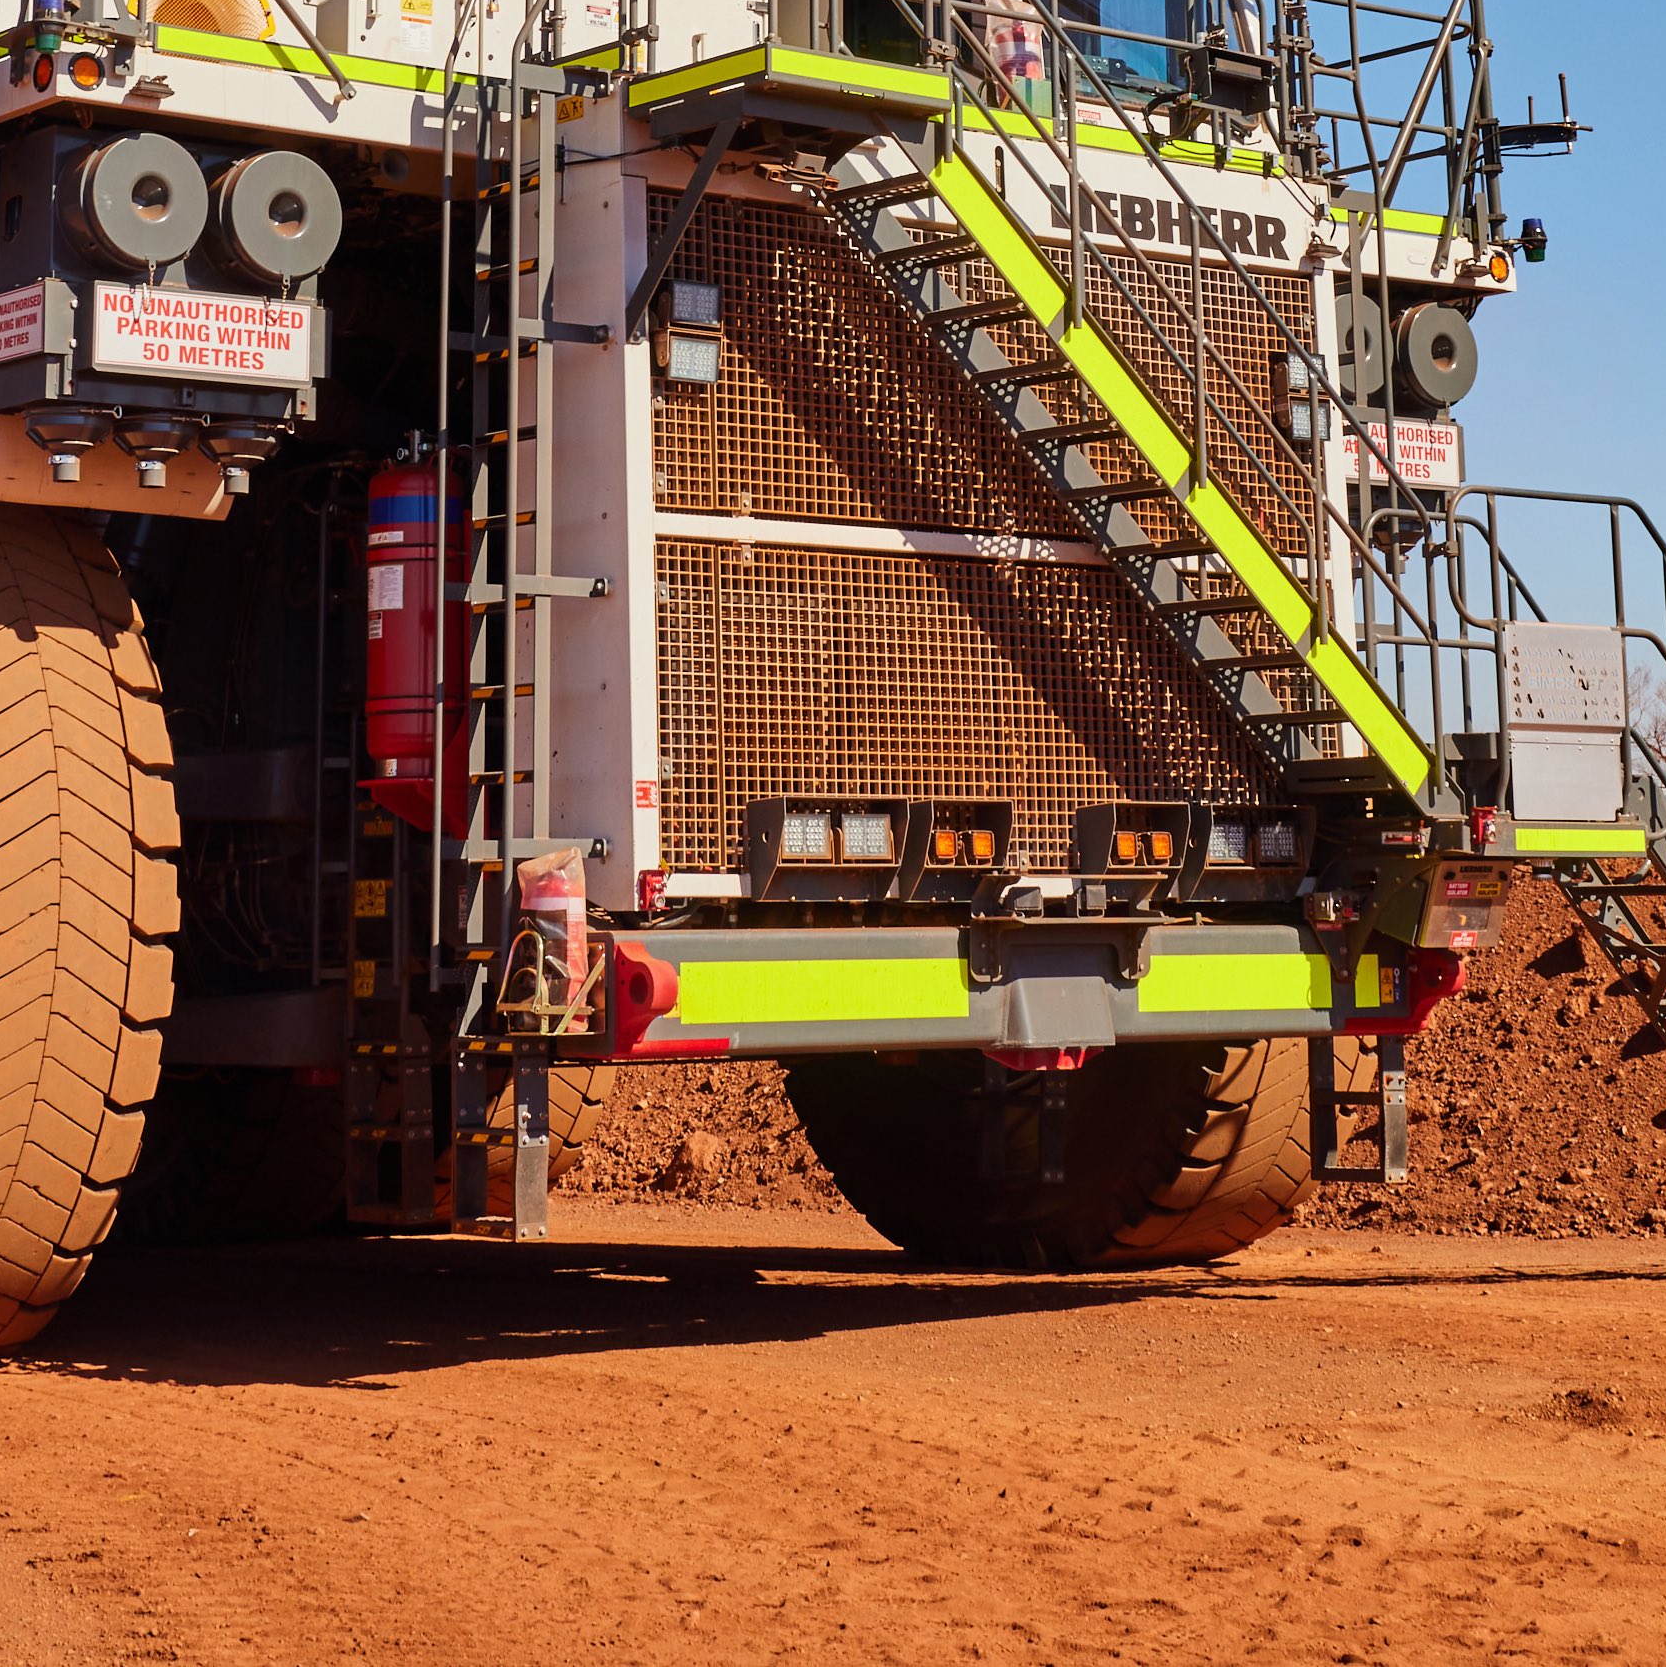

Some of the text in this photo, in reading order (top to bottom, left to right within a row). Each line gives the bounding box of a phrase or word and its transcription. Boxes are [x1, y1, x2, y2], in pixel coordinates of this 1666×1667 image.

[1049, 183, 1290, 261] LIEBHERR
[15, 312, 38, 329] WITHIN
[104, 293, 304, 330] NO UNAUTHORISED
[4, 332, 29, 349] METRES
[117, 317, 290, 351] PARKING WITHIN
[143, 343, 264, 371] 50 METRES
[1399, 444, 1446, 462] WITHIN
[1376, 462, 1431, 479] MTRES
